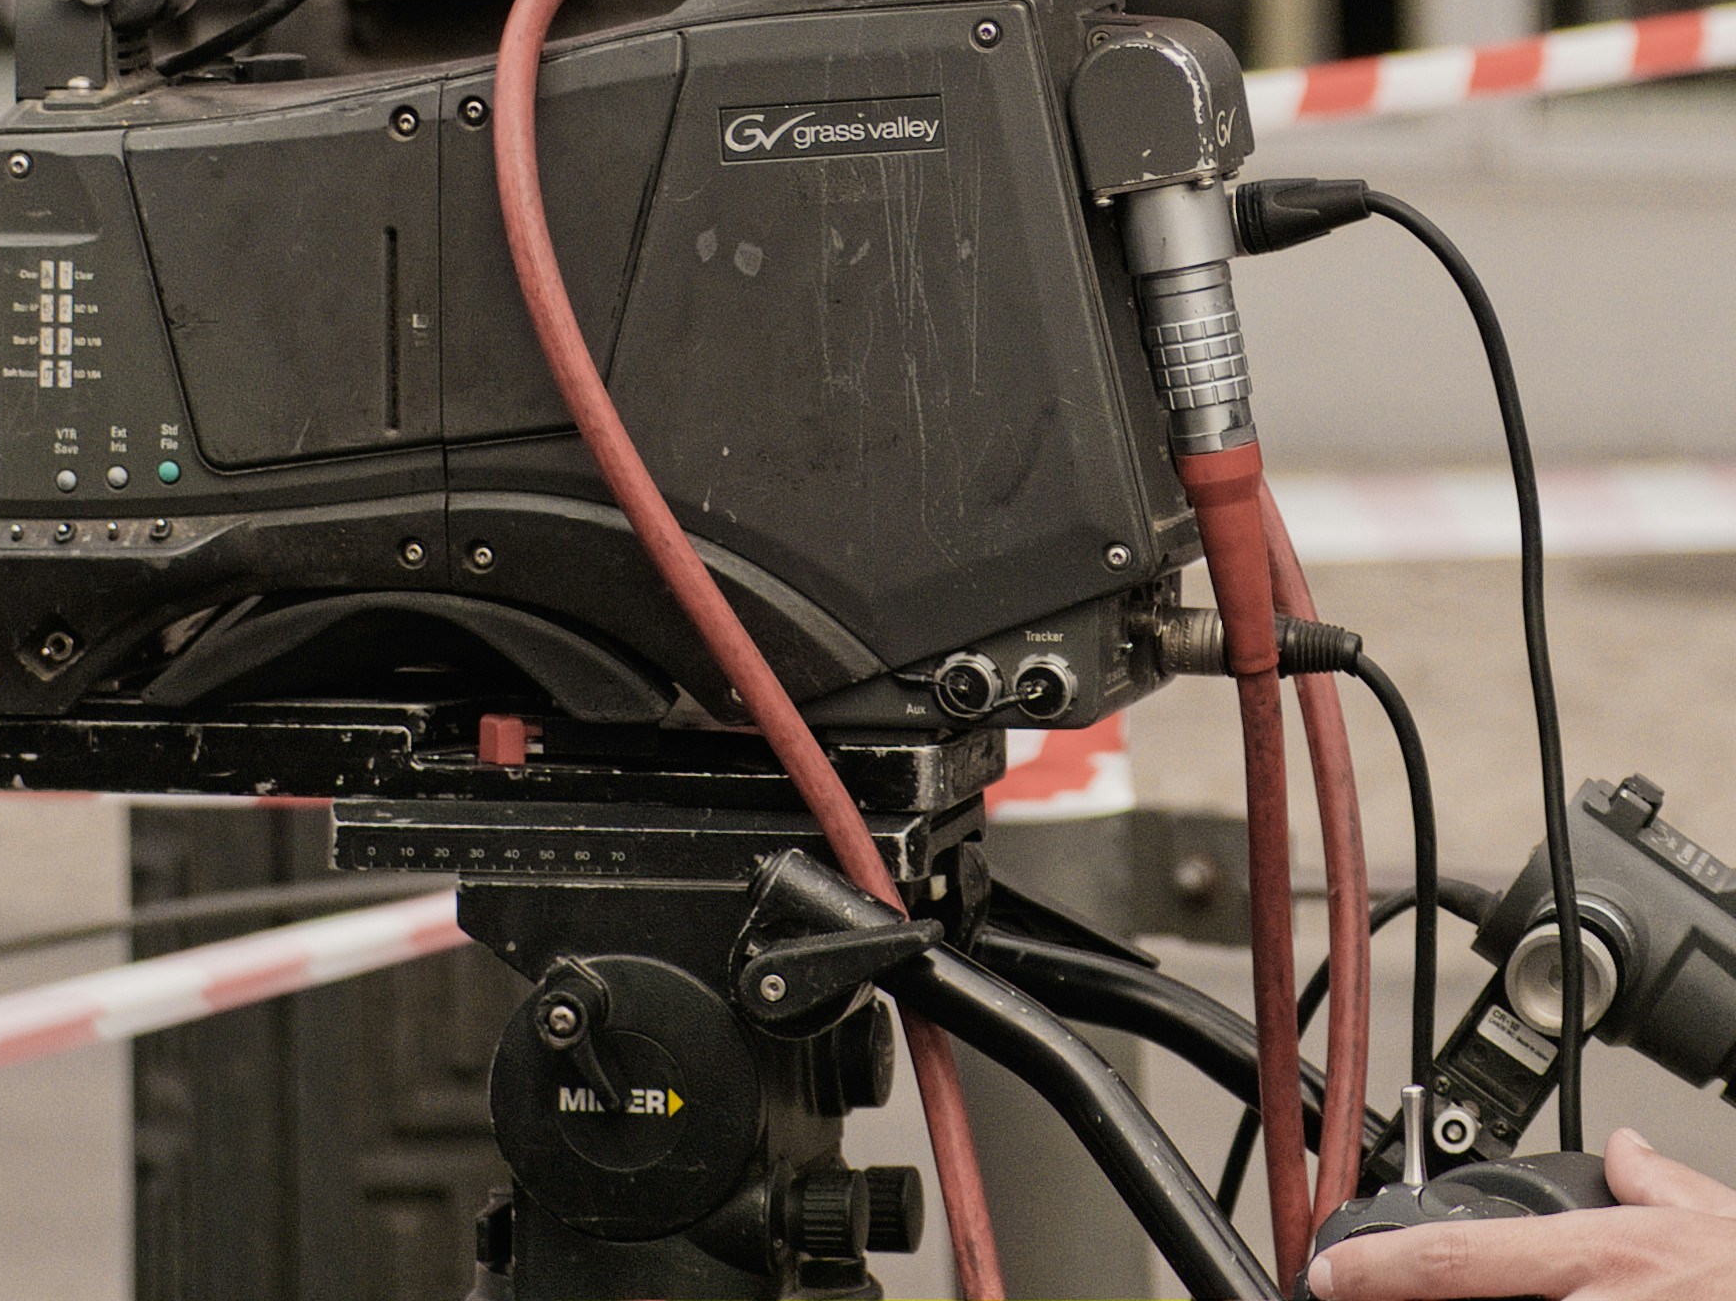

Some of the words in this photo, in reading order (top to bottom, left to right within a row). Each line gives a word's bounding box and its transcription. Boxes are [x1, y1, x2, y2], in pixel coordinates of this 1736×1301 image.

[793, 120, 865, 149] grass
[868, 116, 940, 143] valley
[55, 428, 77, 440] VTR
[110, 425, 128, 438] Ext
[160, 423, 179, 436] Std
[54, 442, 80, 455] Save
[110, 440, 128, 453] Iris
[160, 438, 179, 450] File
[1025, 630, 1065, 643] Tracker
[905, 703, 927, 716] Aux
[367, 846, 376, 857] 0
[400, 847, 415, 857] 10
[434, 847, 450, 858] 20
[469, 848, 485, 859] 30
[503, 849, 520, 859] 40
[539, 850, 556, 860] 50
[610, 851, 626, 862] 70
[558, 1085, 666, 1115] MIER
